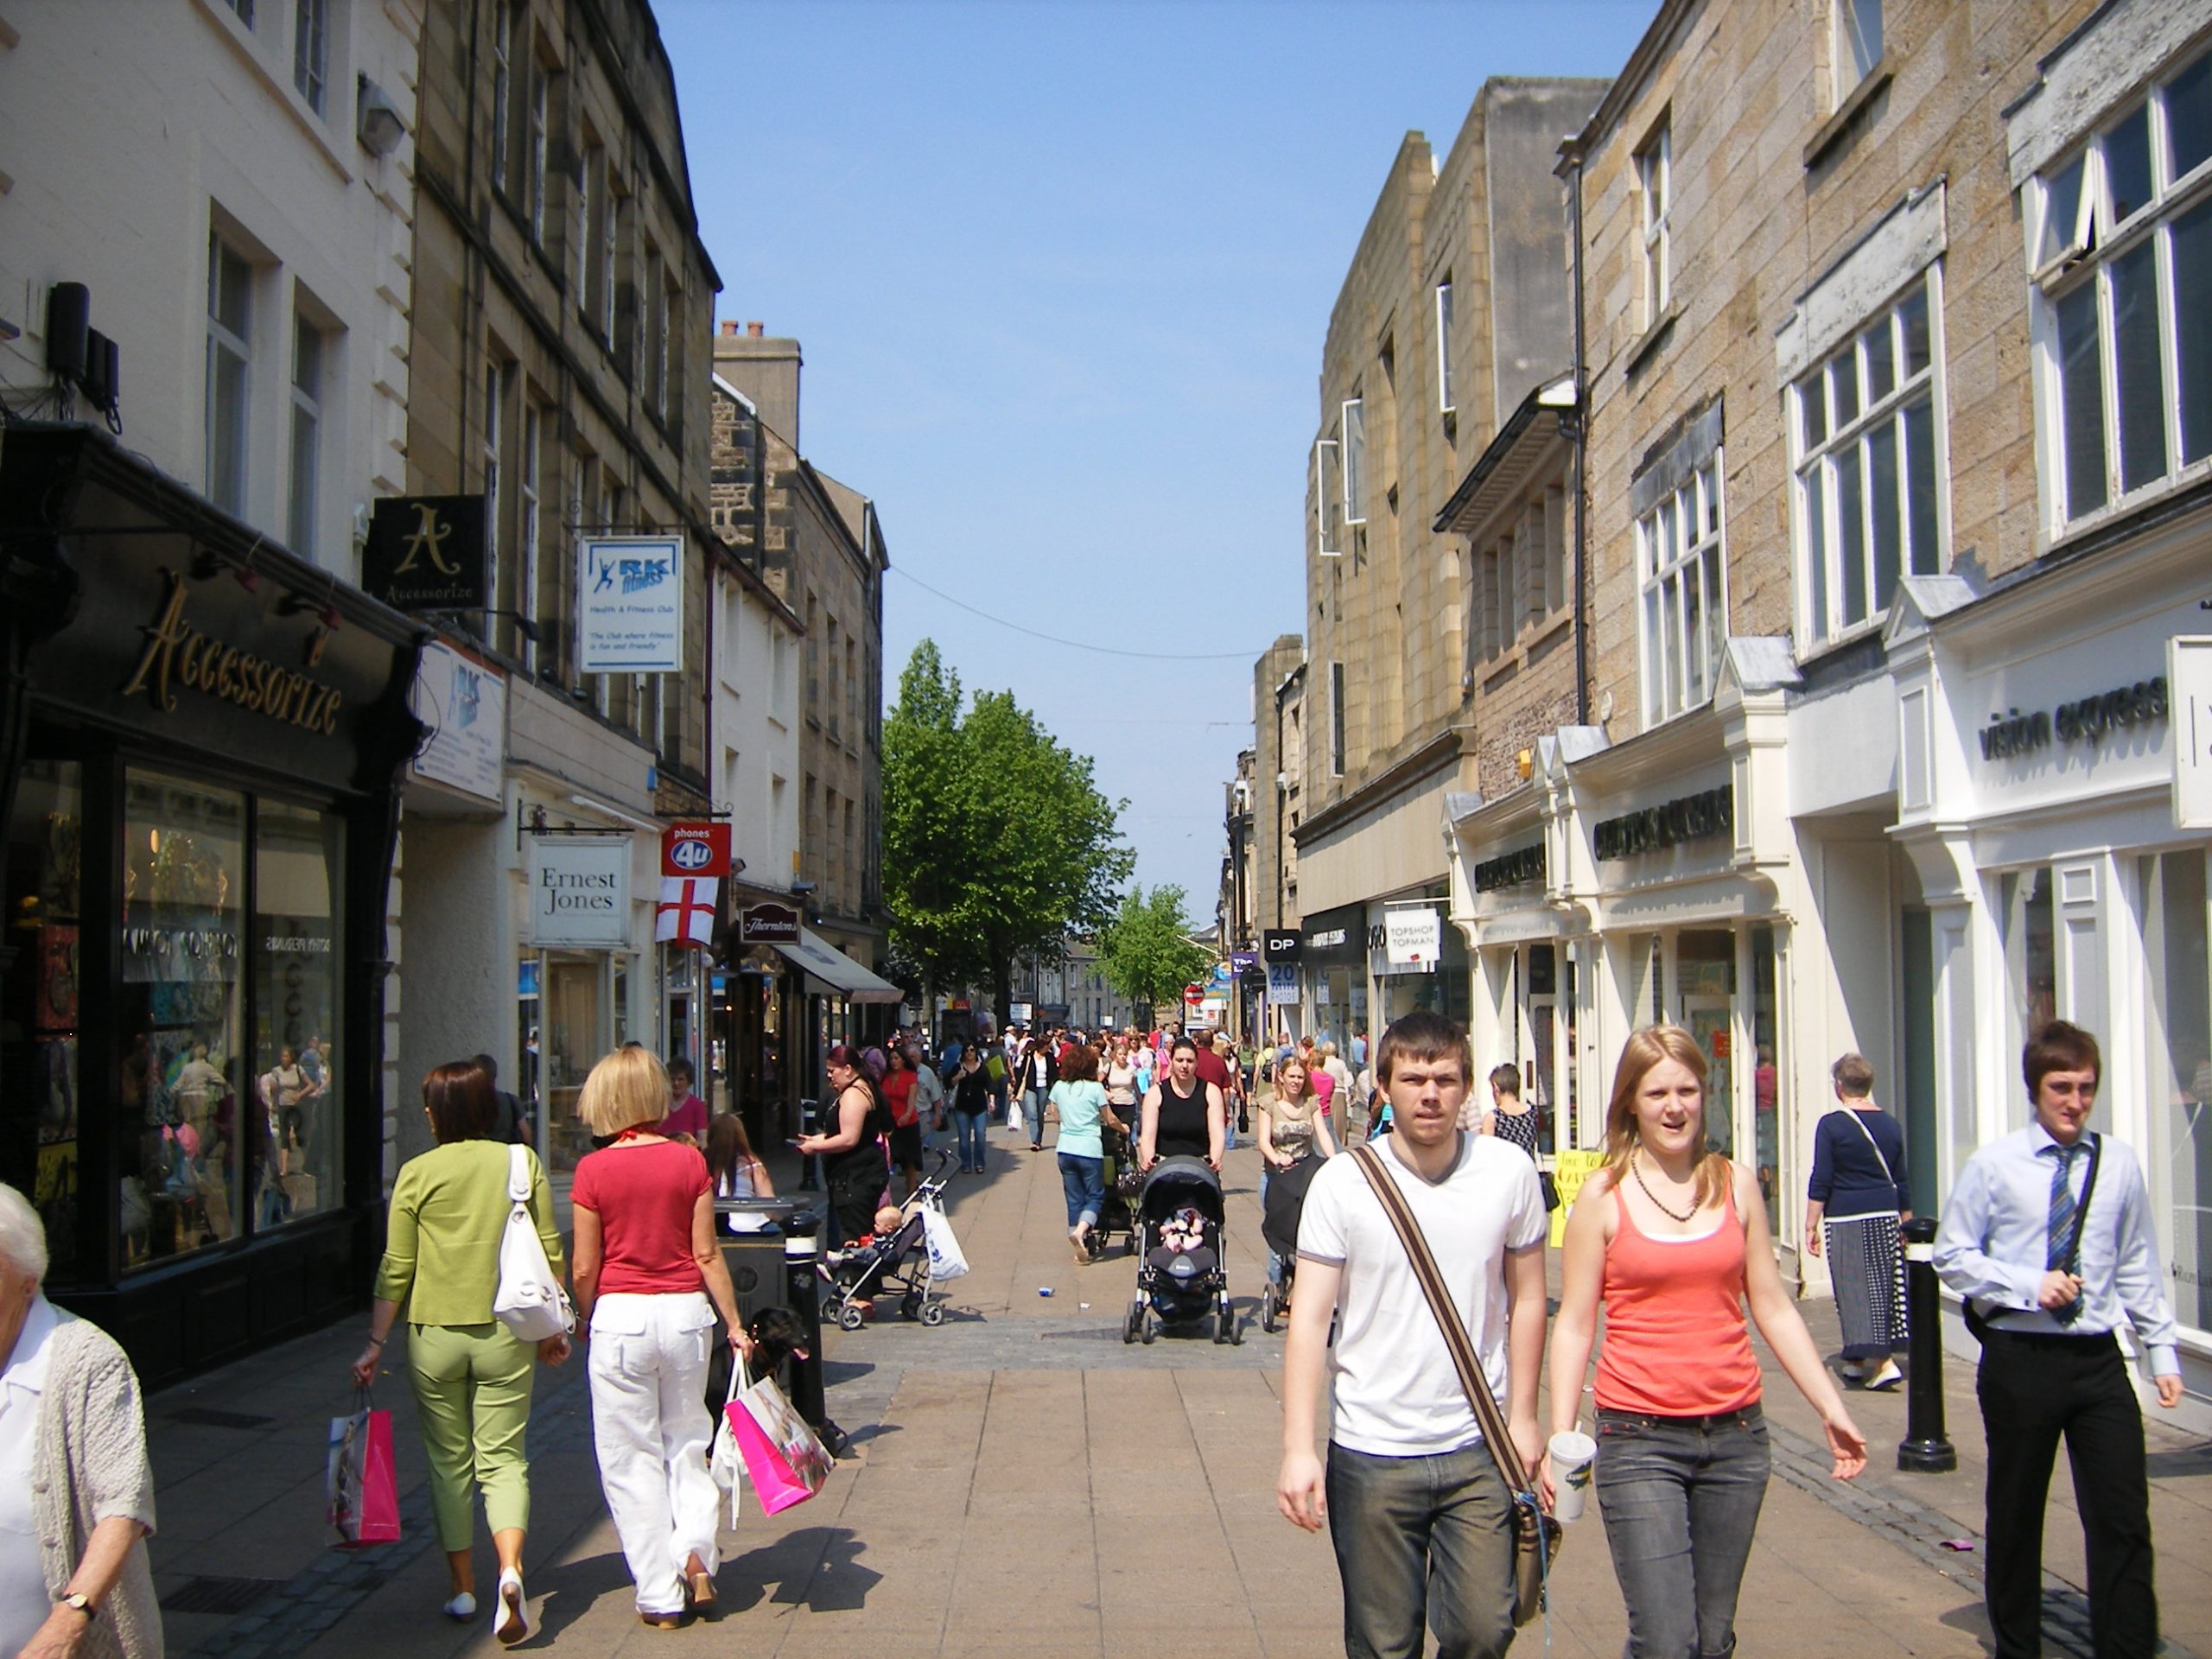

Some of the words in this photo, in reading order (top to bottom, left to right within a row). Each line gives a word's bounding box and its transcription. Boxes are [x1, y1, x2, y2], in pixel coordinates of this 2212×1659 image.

[620, 559, 669, 575] RK
[622, 572, 663, 594] fitness
[385, 582, 473, 604] Accessorize
[627, 605, 654, 613] Fitness
[124, 570, 341, 735] Accessorize
[1980, 708, 2051, 761] vision
[2056, 677, 2168, 748] express
[674, 828, 710, 839] phones
[676, 842, 709, 868] 4u
[543, 867, 616, 888] Ernest
[544, 889, 613, 915] Jones
[744, 918, 798, 934] Thorntons
[1390, 925, 1434, 937] TOPSHOP
[1270, 939, 1294, 950] DP
[1393, 937, 1434, 947] TOPMAN
[1271, 963, 1294, 982] 20
